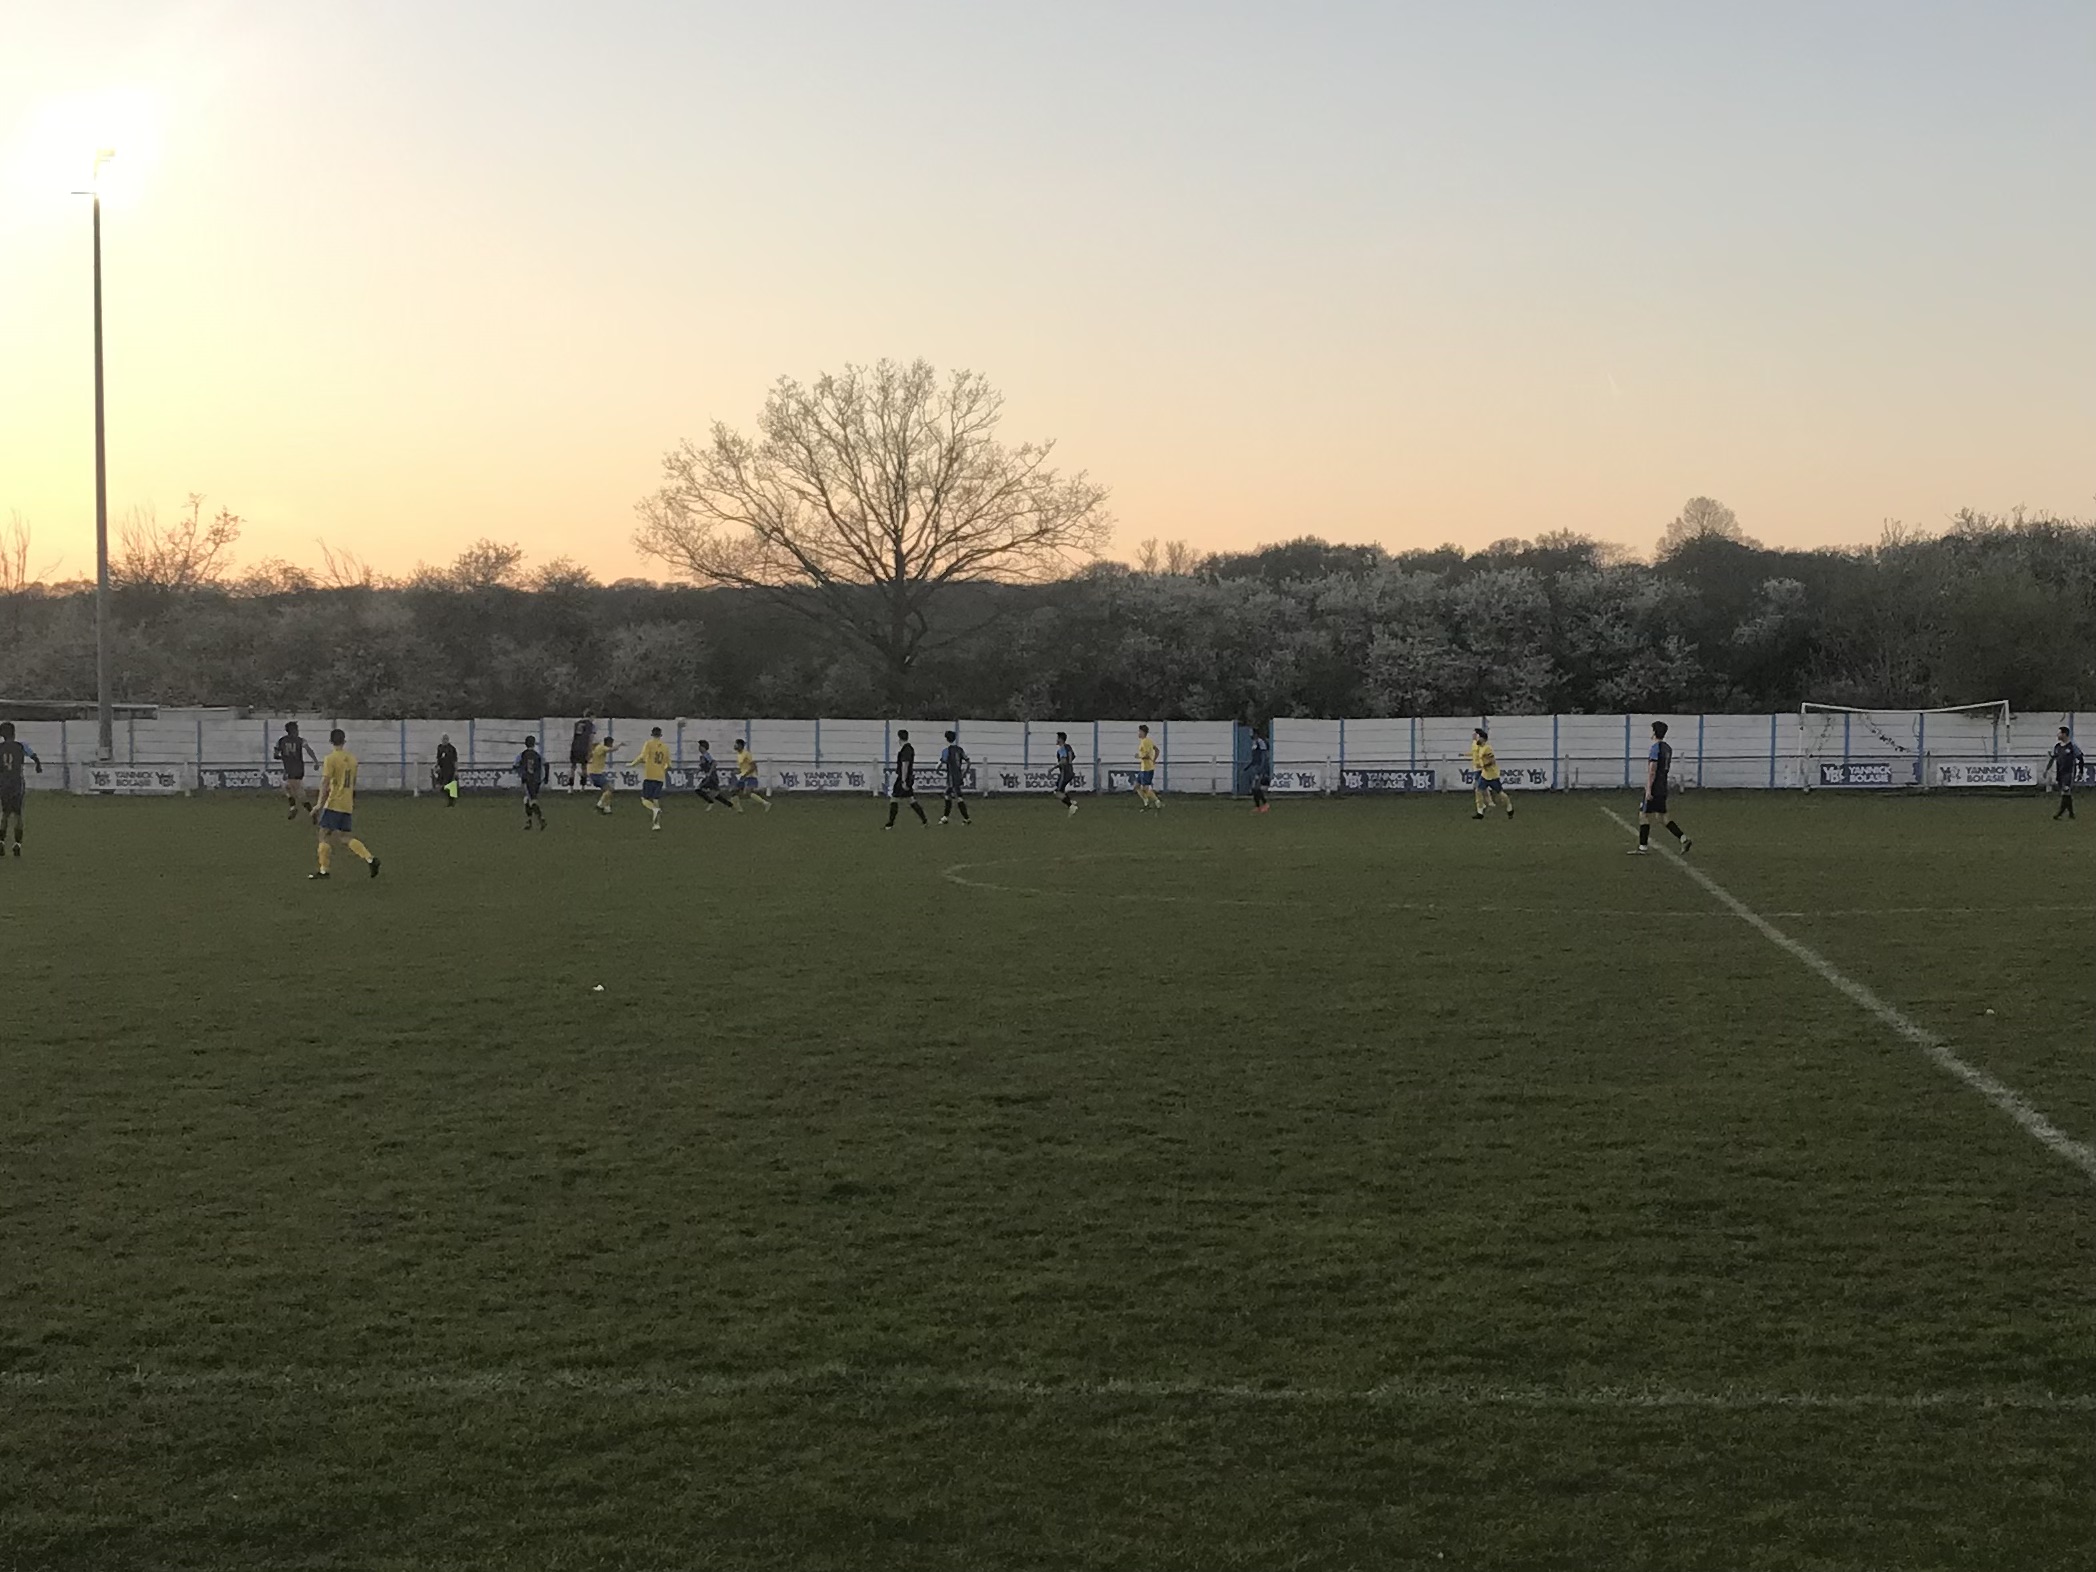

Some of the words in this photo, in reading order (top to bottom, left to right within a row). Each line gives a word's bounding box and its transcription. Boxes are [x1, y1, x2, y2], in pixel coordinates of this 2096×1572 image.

[1848, 766, 1891, 774] YANNICK
[1965, 766, 2008, 774] YANNICK
[1366, 772, 1408, 780] YANNICK
[1849, 774, 1889, 782] BOLASIE
[1967, 774, 2006, 782] BOLASIE
